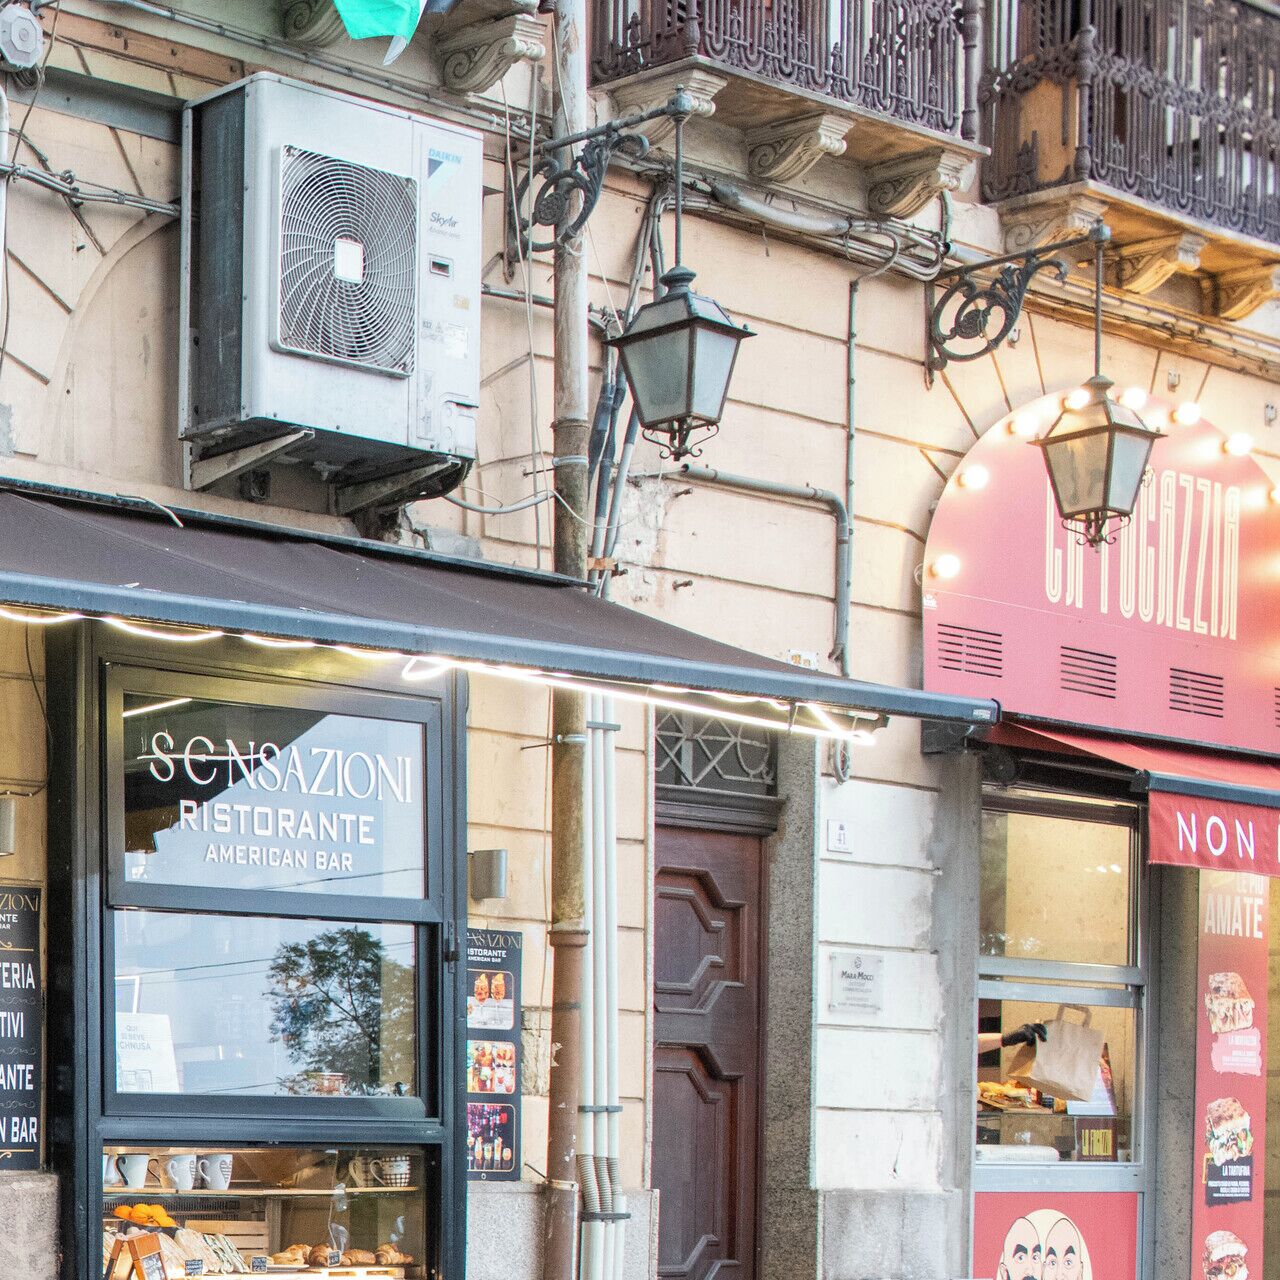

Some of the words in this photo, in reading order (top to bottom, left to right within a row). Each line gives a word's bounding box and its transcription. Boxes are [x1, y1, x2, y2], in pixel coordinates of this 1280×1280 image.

[148, 732, 412, 803] SENSAZIONI
[178, 799, 376, 845] RISTORANTE
[1176, 811, 1255, 861] NON
[204, 843, 308, 869] AMERICAN
[315, 850, 353, 872] BAR
[1204, 893, 1264, 939] AMATE
[467, 948, 507, 958] ISTORANTE
[11, 1116, 38, 1143] BAR
